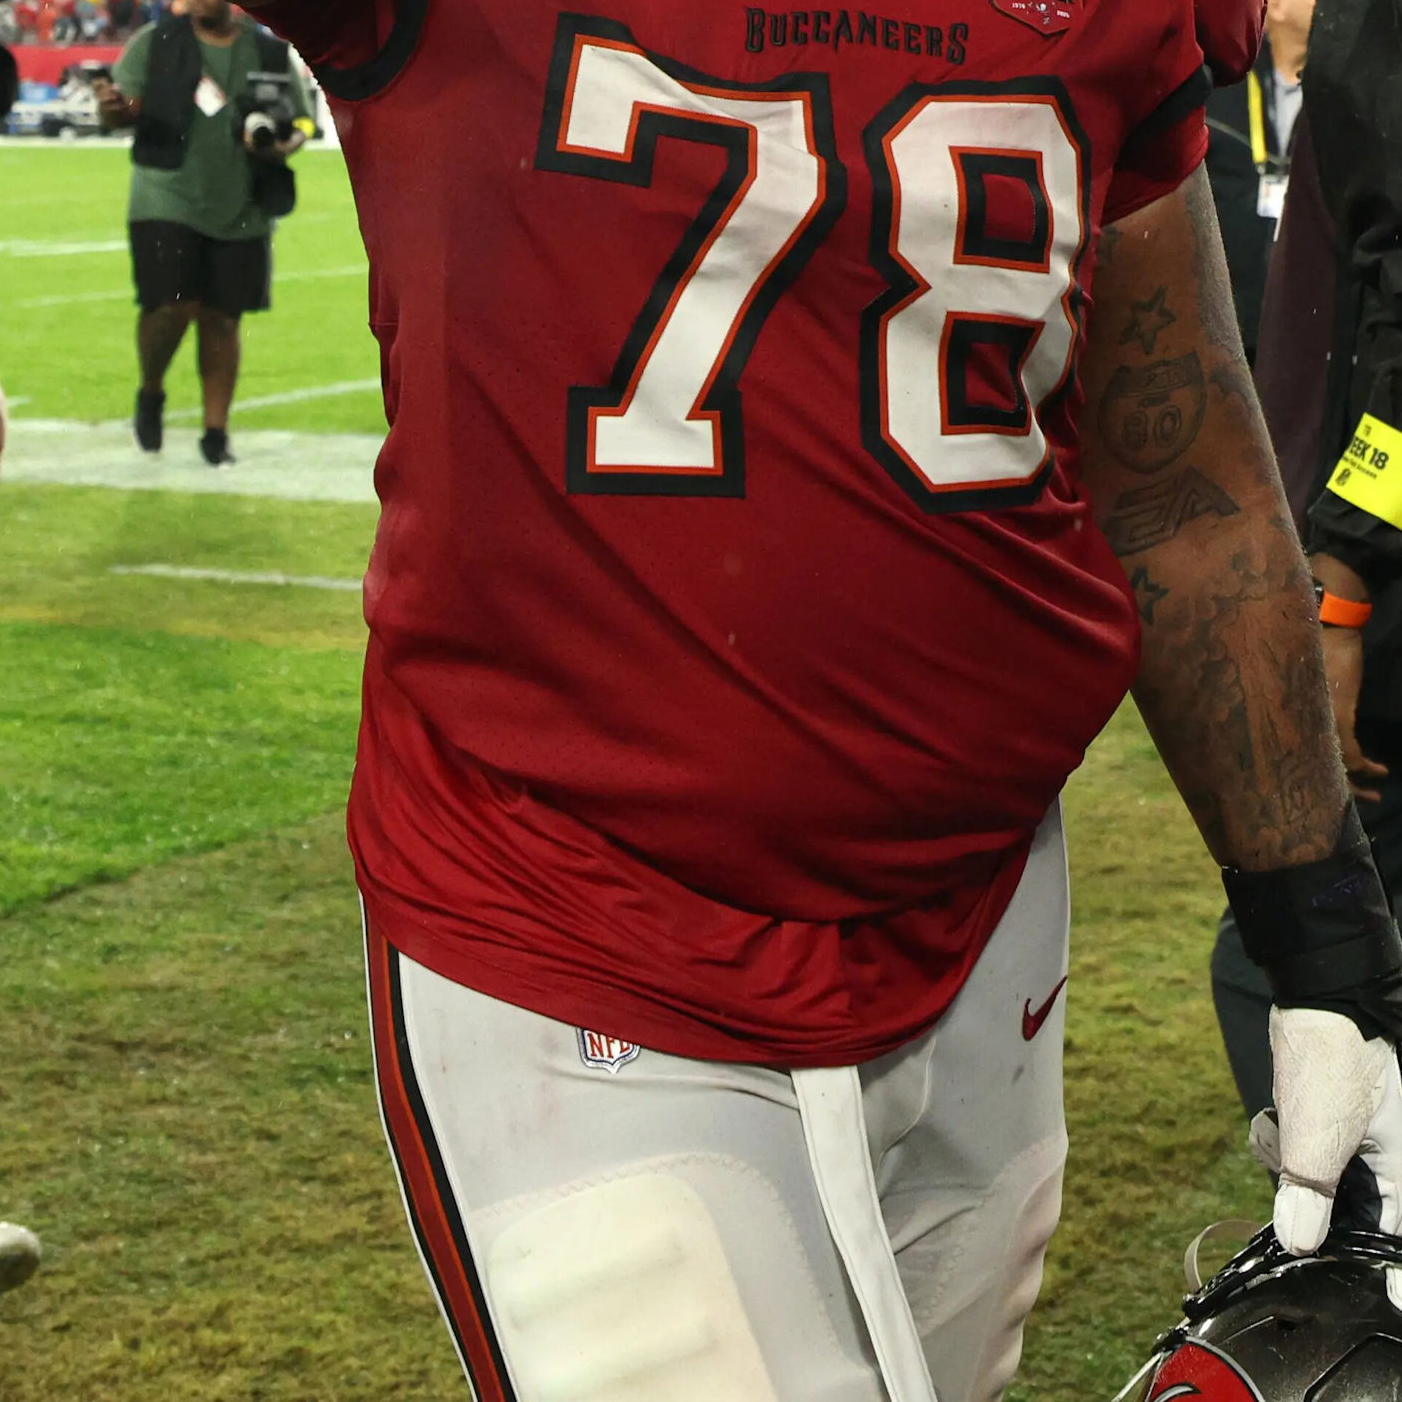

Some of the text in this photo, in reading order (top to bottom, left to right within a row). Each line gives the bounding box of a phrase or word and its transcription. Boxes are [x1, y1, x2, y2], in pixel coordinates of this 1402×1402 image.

[743, 5, 969, 66] BUCCANEERS
[541, 17, 1091, 509] 78
[1347, 435, 1372, 462] EEK
[1369, 447, 1390, 471] 18
